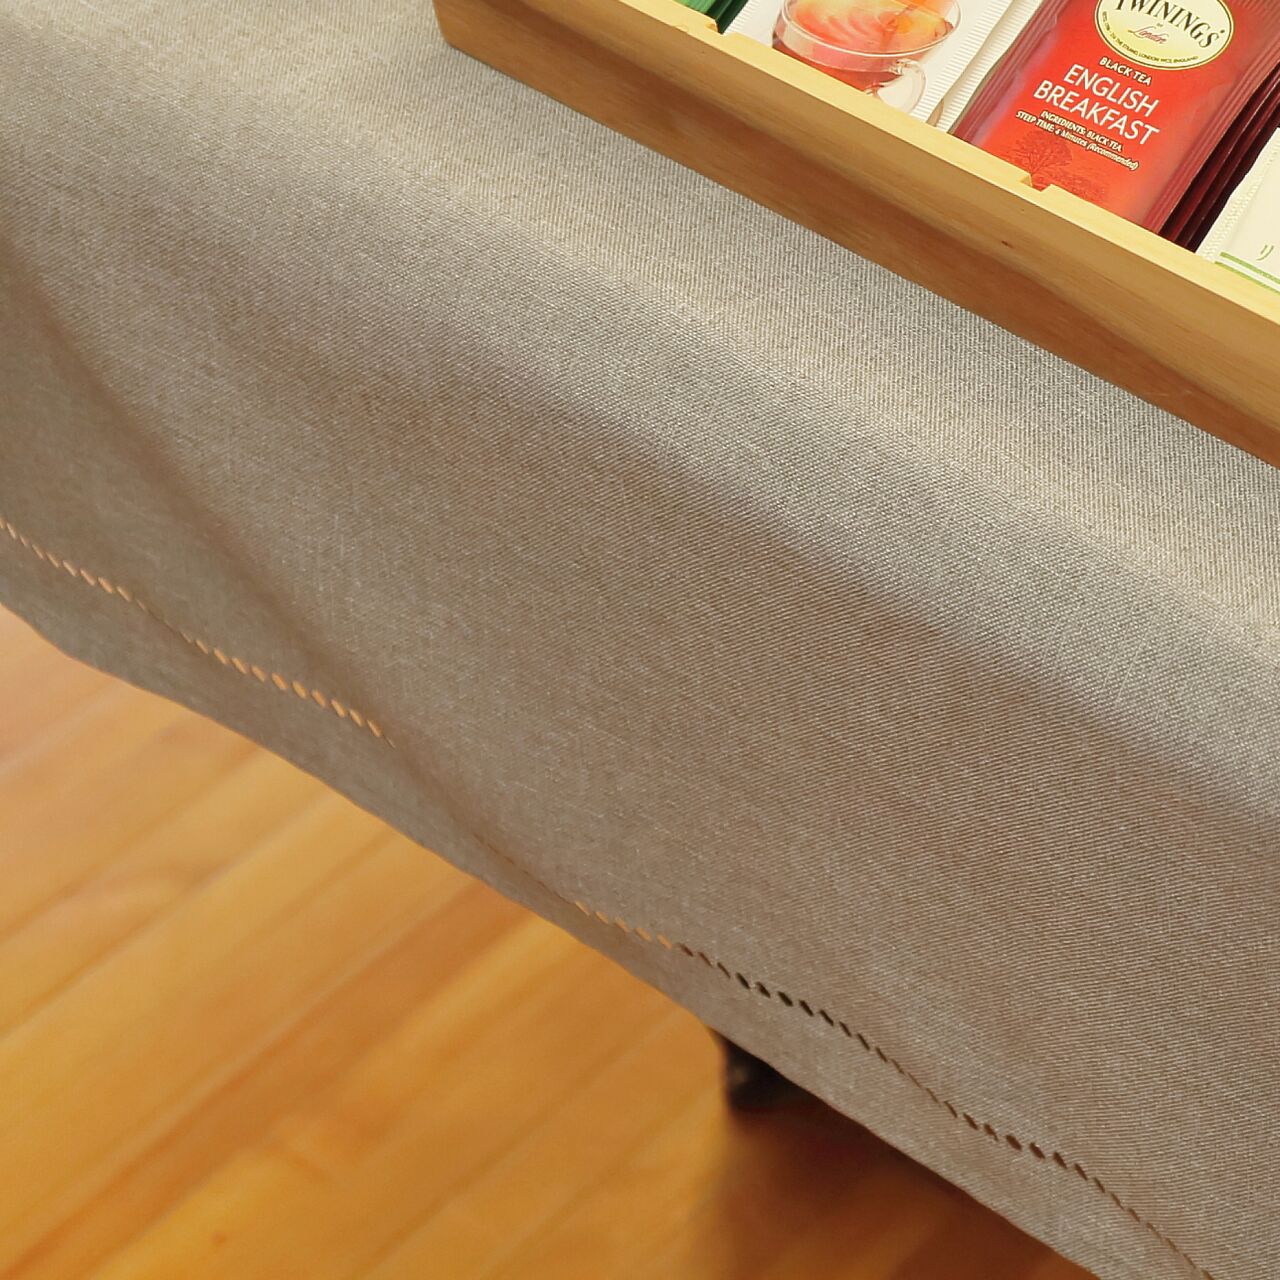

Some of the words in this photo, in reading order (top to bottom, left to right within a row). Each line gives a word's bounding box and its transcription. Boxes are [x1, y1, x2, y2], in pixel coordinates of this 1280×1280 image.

[1099, 56, 1133, 77] BLACK
[1132, 69, 1152, 86] TEA
[1063, 63, 1160, 118] ENGLISH
[1016, 110, 1037, 123] STEEP
[1033, 80, 1160, 145] BREAKFAST
[1086, 131, 1108, 146] BLACK
[1108, 140, 1122, 152] TEA
